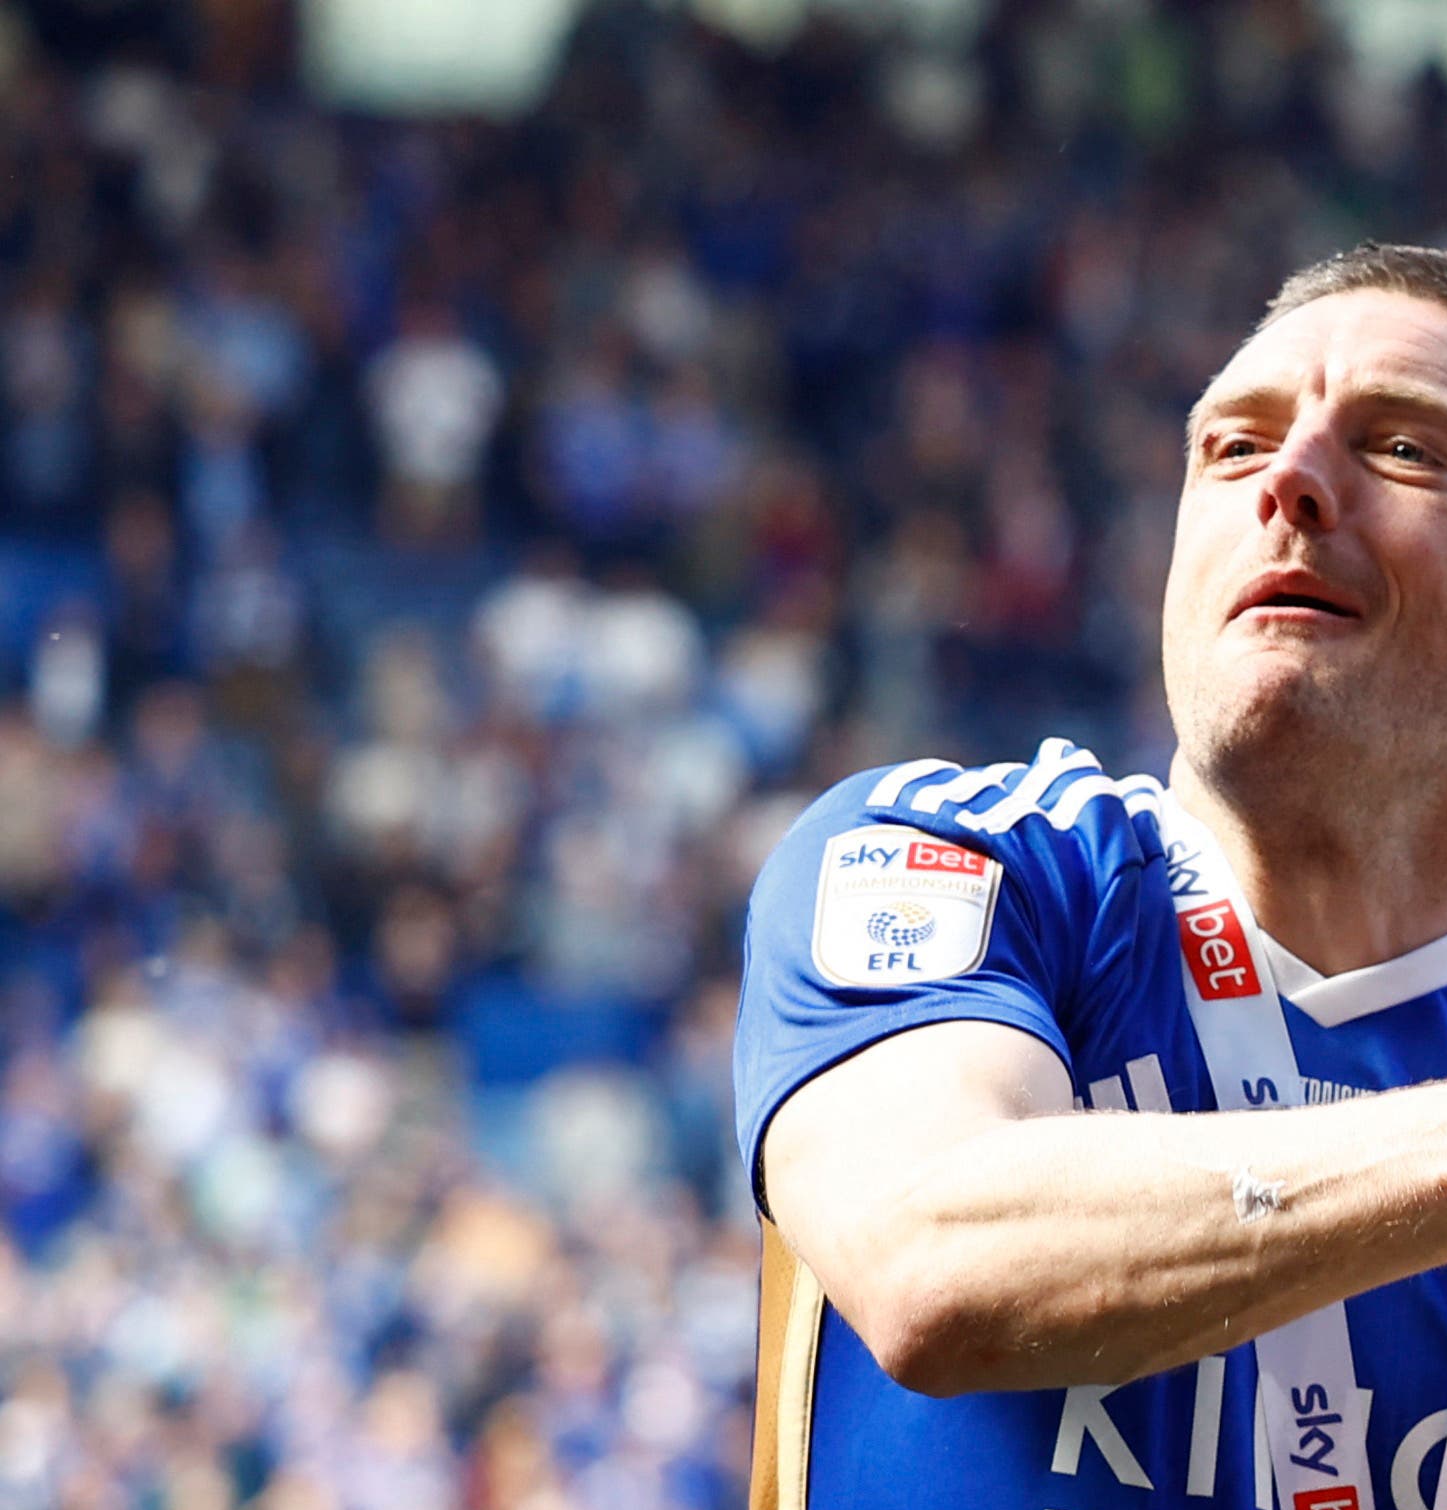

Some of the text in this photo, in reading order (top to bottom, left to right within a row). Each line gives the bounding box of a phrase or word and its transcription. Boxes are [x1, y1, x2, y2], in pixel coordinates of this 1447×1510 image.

[839, 844, 981, 870] sky bet
[867, 952, 922, 971] EFL
[1186, 905, 1247, 991] bet
[1290, 1384, 1343, 1477] sky
